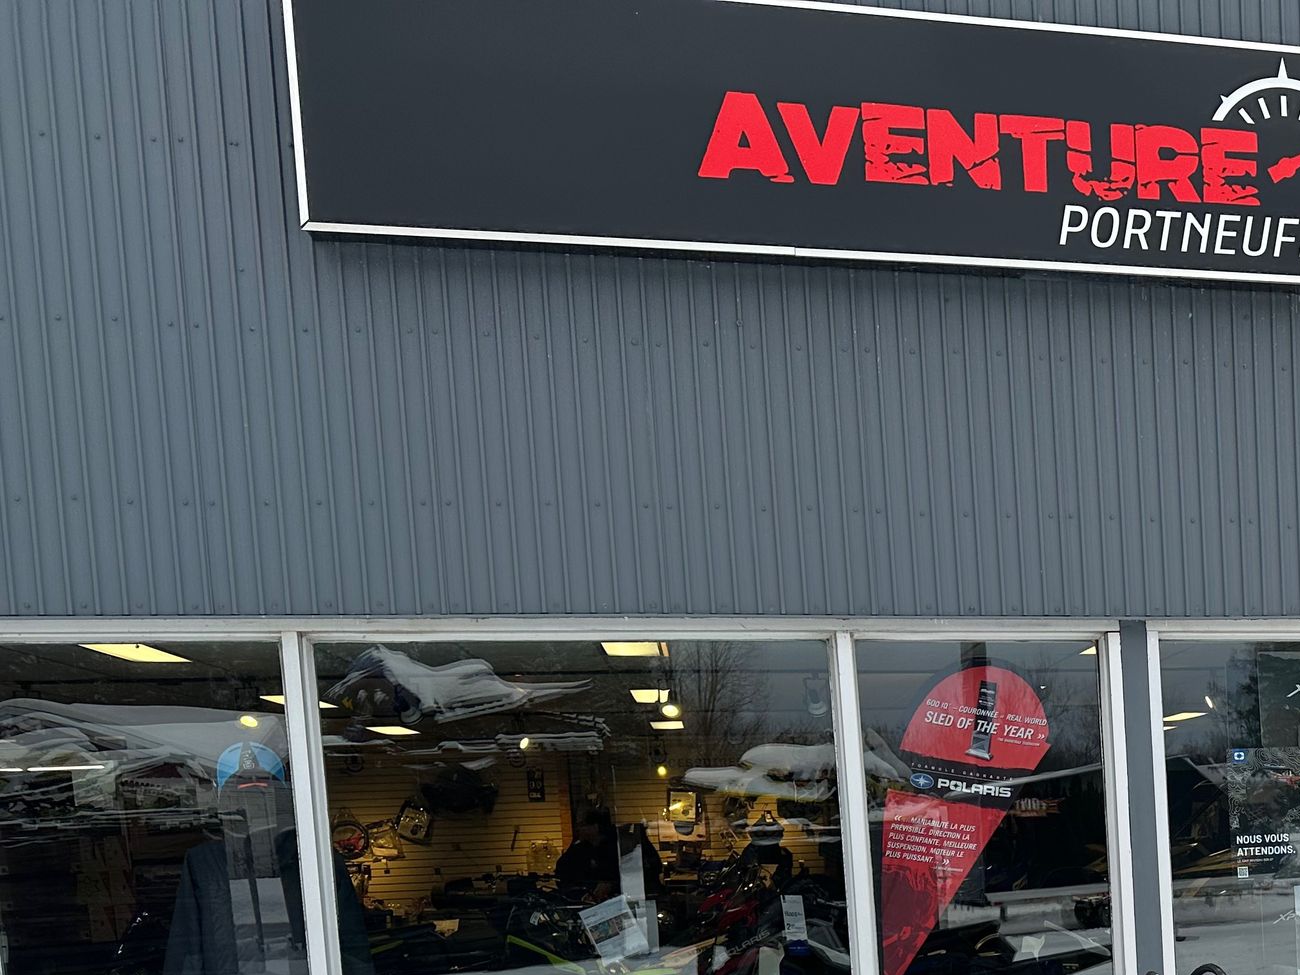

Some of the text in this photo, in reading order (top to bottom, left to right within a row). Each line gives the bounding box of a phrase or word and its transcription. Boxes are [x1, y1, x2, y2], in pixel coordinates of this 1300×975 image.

[698, 91, 1261, 206] AVENTURE
[1059, 204, 1300, 258] PORTNEUF
[925, 710, 1034, 740] SLED OF THE YEAR
[1006, 713, 1023, 723] REAL
[1024, 717, 1047, 726] WORLD
[937, 778, 1011, 798] POLARIS
[928, 827, 961, 840] DIRECTION
[950, 822, 958, 830] LA
[959, 823, 976, 832] PLUS
[888, 832, 905, 841] PLUS
[942, 841, 977, 851] MEILLEURE
[1236, 833, 1290, 845] NOUS VOUS
[885, 850, 901, 859] PLUS
[929, 847, 956, 857] MOTEUR
[1236, 845, 1297, 857] ATTENDONS.
[727, 929, 770, 956] OLARIS
